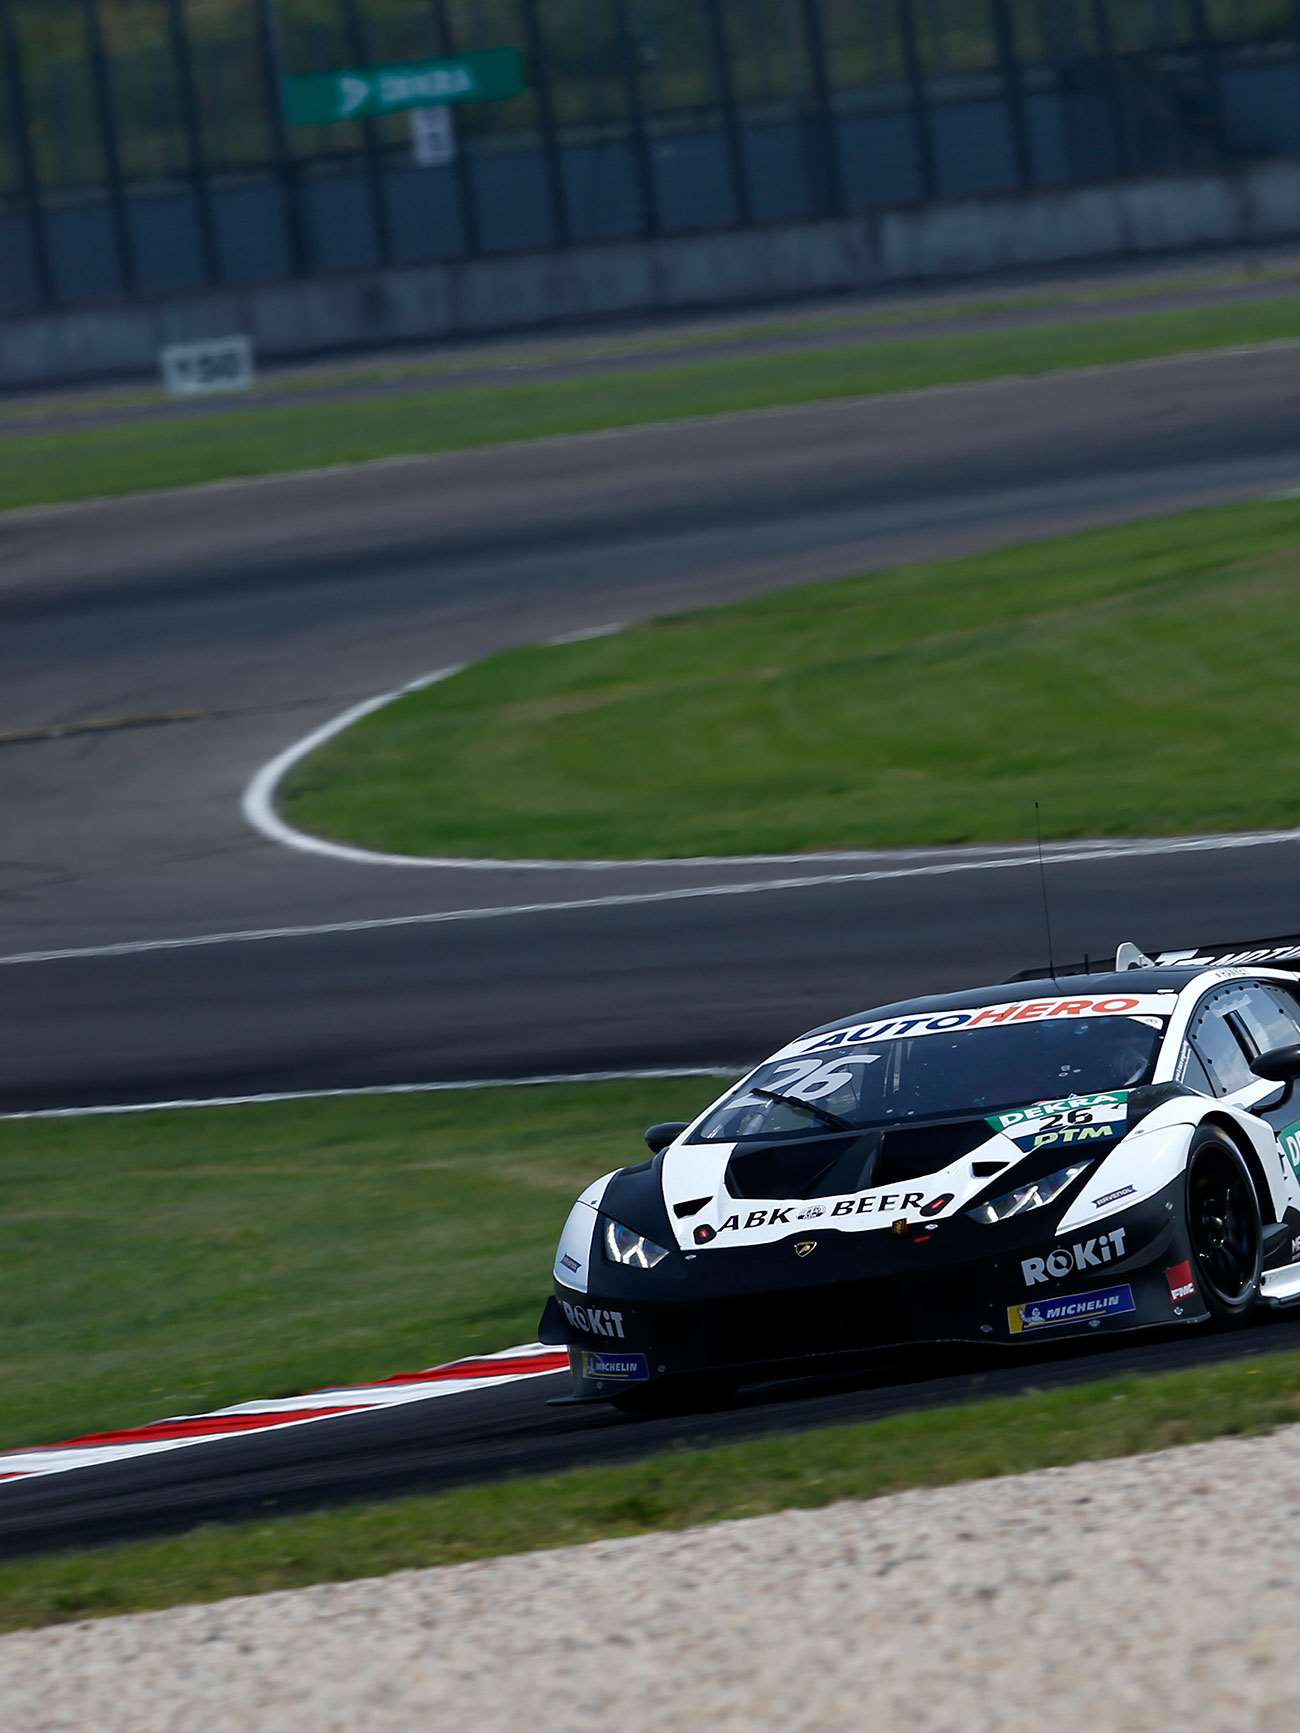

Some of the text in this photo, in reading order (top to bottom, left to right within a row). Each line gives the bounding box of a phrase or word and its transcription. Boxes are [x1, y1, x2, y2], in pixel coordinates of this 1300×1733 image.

[801, 997, 1139, 1052] AUTOHERO
[723, 1054, 881, 1111] 26
[999, 1094, 1119, 1129] DEKRA
[1038, 1107, 1094, 1133] 26
[1033, 1125, 1113, 1147] DTM
[716, 1207, 796, 1233] ABK
[830, 1192, 925, 1217] BEER
[1046, 1295, 1120, 1319] MICHELIN
[595, 1361, 638, 1373] MICHELIN
